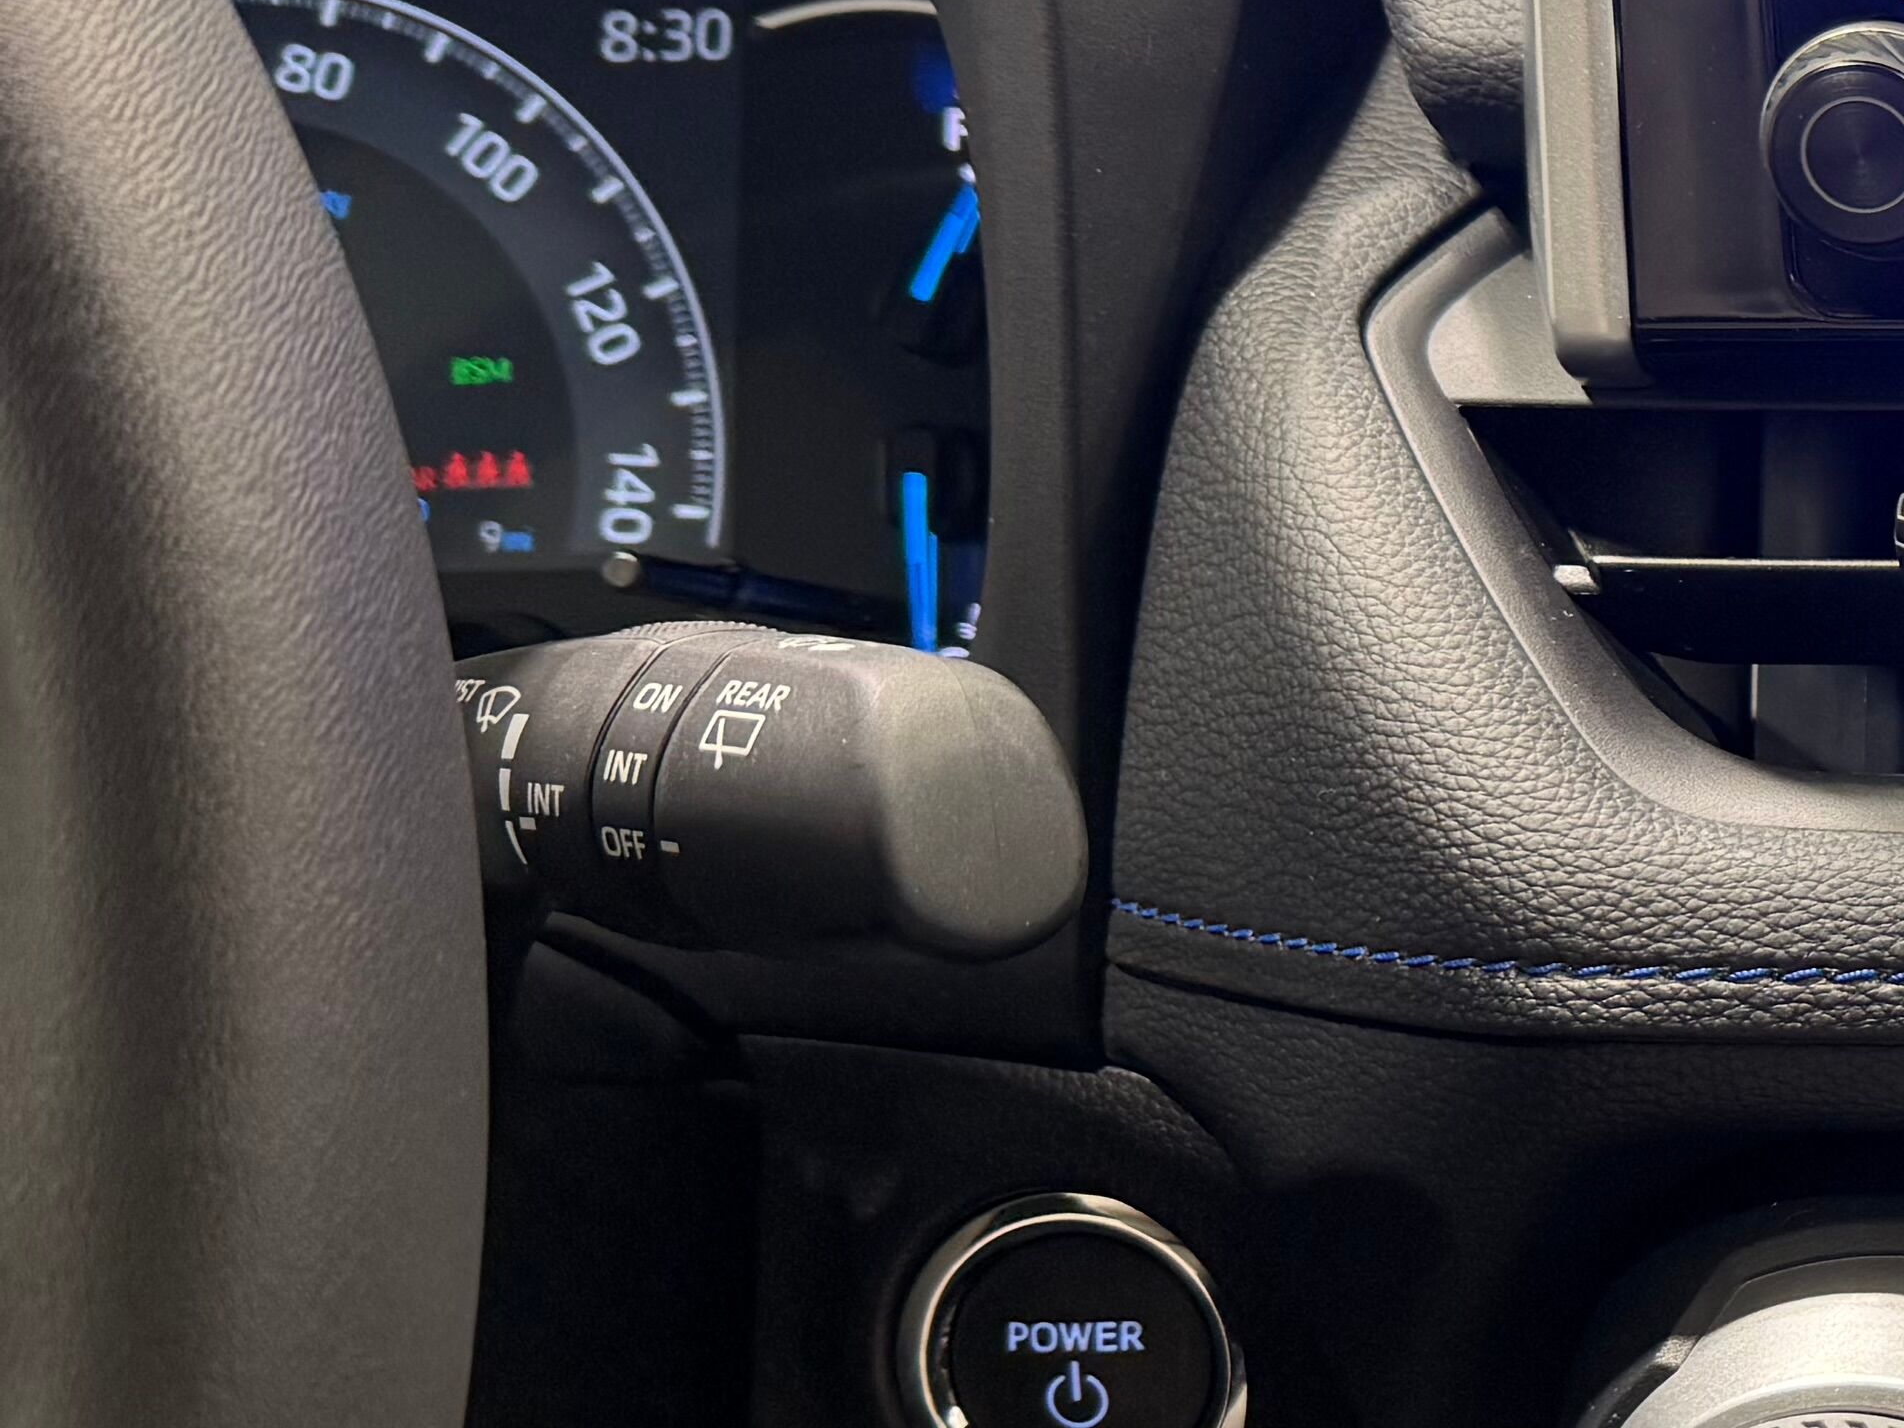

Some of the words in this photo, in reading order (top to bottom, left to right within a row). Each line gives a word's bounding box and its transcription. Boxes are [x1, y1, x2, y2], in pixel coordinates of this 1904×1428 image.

[600, 8, 732, 63] 8:30
[274, 43, 353, 101] 80
[443, 112, 540, 203] 100
[566, 262, 641, 366] 120
[600, 444, 660, 545] 140
[456, 679, 486, 703] IST
[633, 682, 683, 713] ON
[716, 679, 791, 711] REAR
[603, 749, 648, 785] INT
[527, 782, 565, 817] INT
[601, 826, 646, 859] OFF
[1008, 1321, 1145, 1353] POWER
